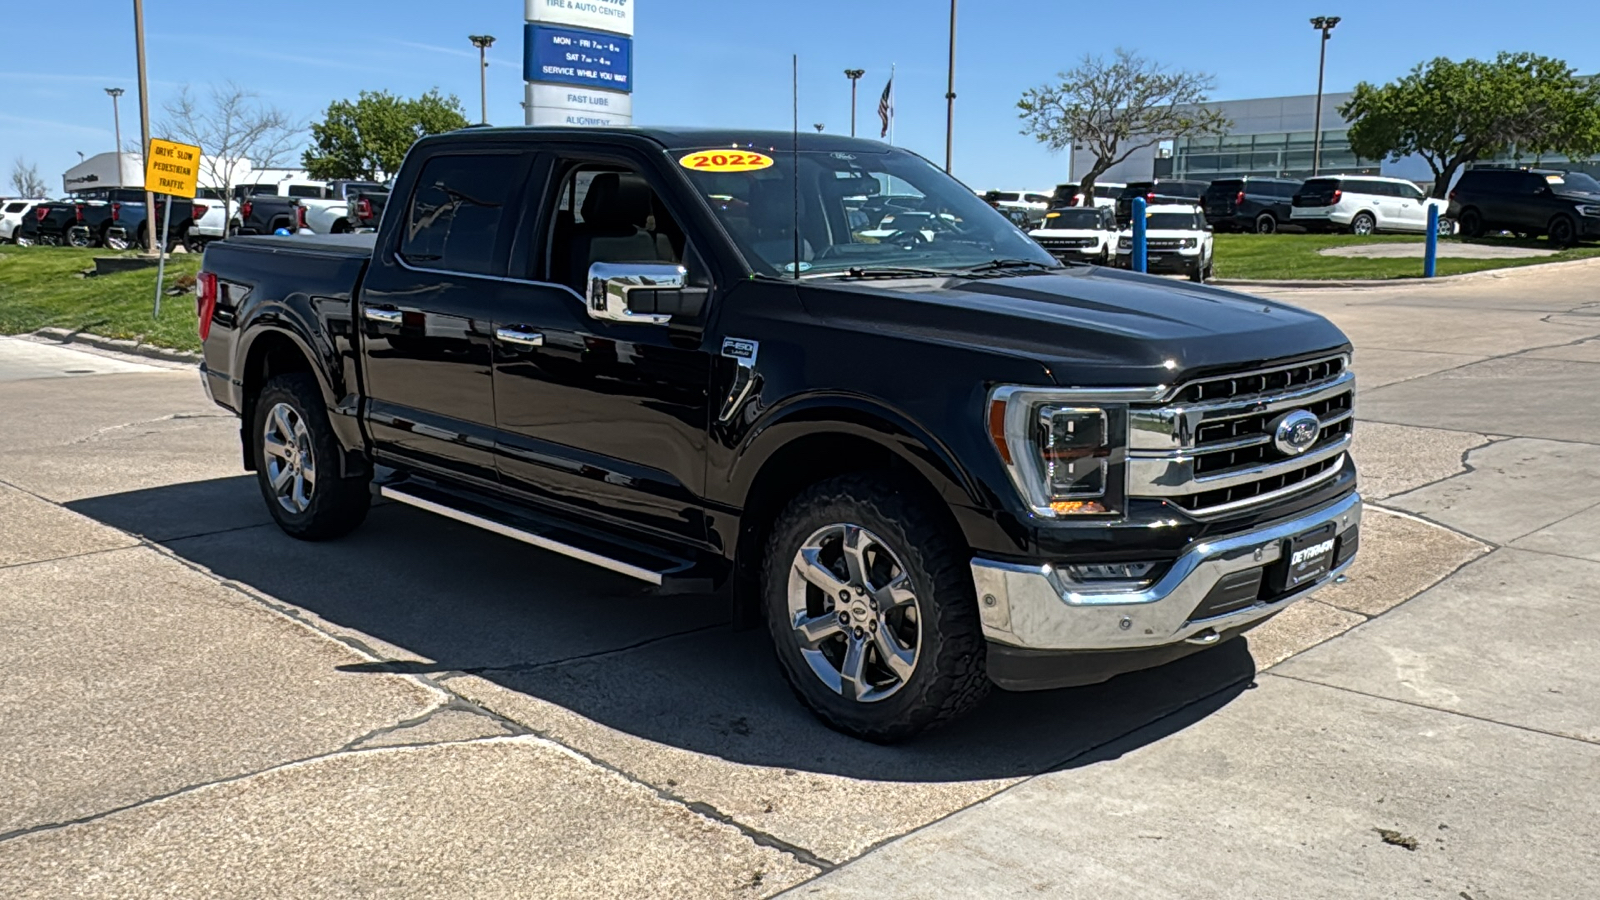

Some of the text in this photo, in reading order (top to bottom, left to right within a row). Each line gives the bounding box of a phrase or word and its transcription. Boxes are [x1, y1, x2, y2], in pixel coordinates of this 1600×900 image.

[546, 0, 565, 8] TIRE
[567, 1, 573, 9] &
[575, 2, 597, 13] AUTO
[598, 6, 626, 18] CENTER
[553, 36, 571, 45] MON
[580, 39, 591, 48] FRI
[566, 52, 579, 61] SAT
[542, 66, 575, 76] SERVICE
[577, 69, 598, 79] WHILE
[600, 72, 613, 80] YOU
[567, 94, 609, 106] FAST LUBE
[566, 116, 611, 126] ALIGNMENT
[155, 146, 193, 161] DRIVE SLOW
[693, 155, 764, 167] 2022
[153, 161, 191, 176] PEDESTRIAN
[159, 177, 185, 190] TRAFFIC
